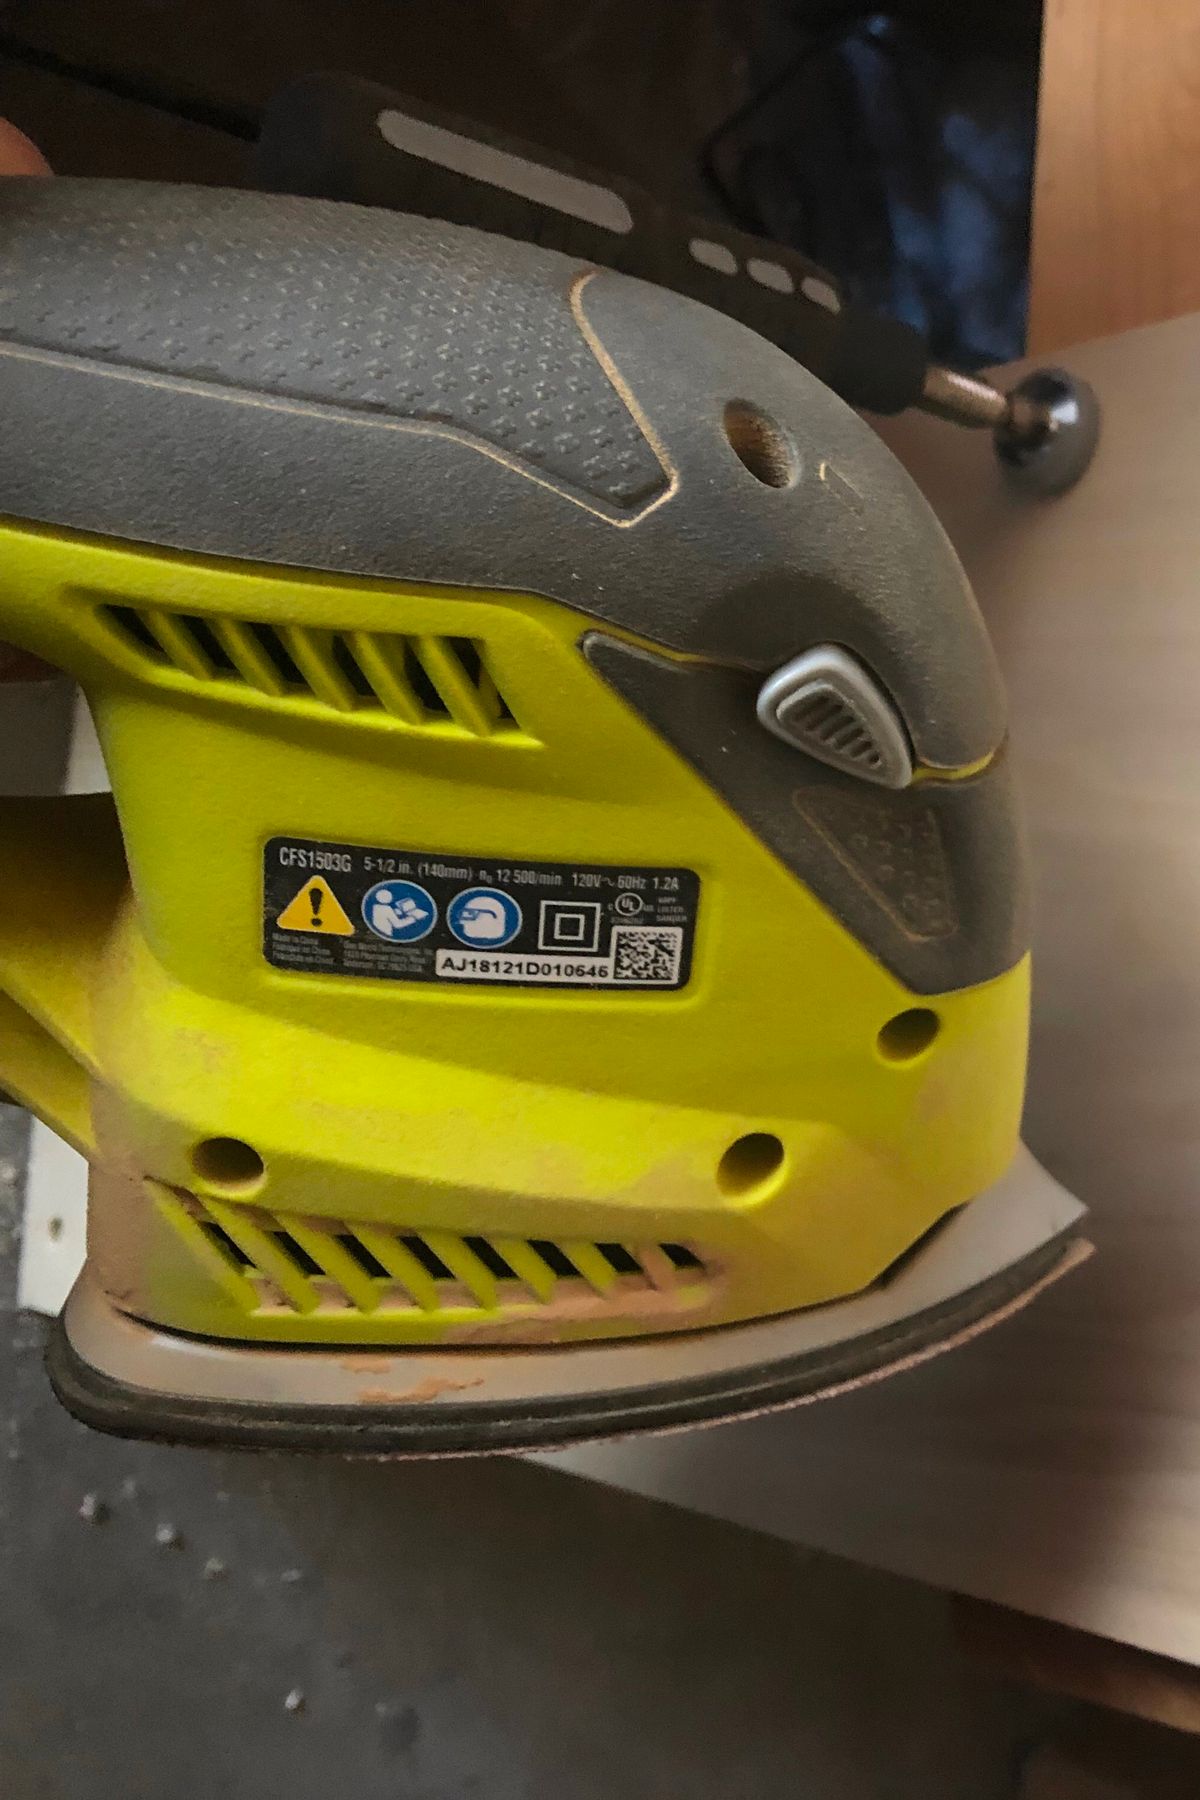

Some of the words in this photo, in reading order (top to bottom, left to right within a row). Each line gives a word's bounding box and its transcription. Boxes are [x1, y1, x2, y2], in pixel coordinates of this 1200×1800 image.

[279, 846, 352, 873] CFS1503G
[364, 856, 395, 873] 5-1/2
[417, 863, 473, 882] (140mm)
[617, 875, 646, 890] 60Hz
[652, 876, 679, 891] 1.2A
